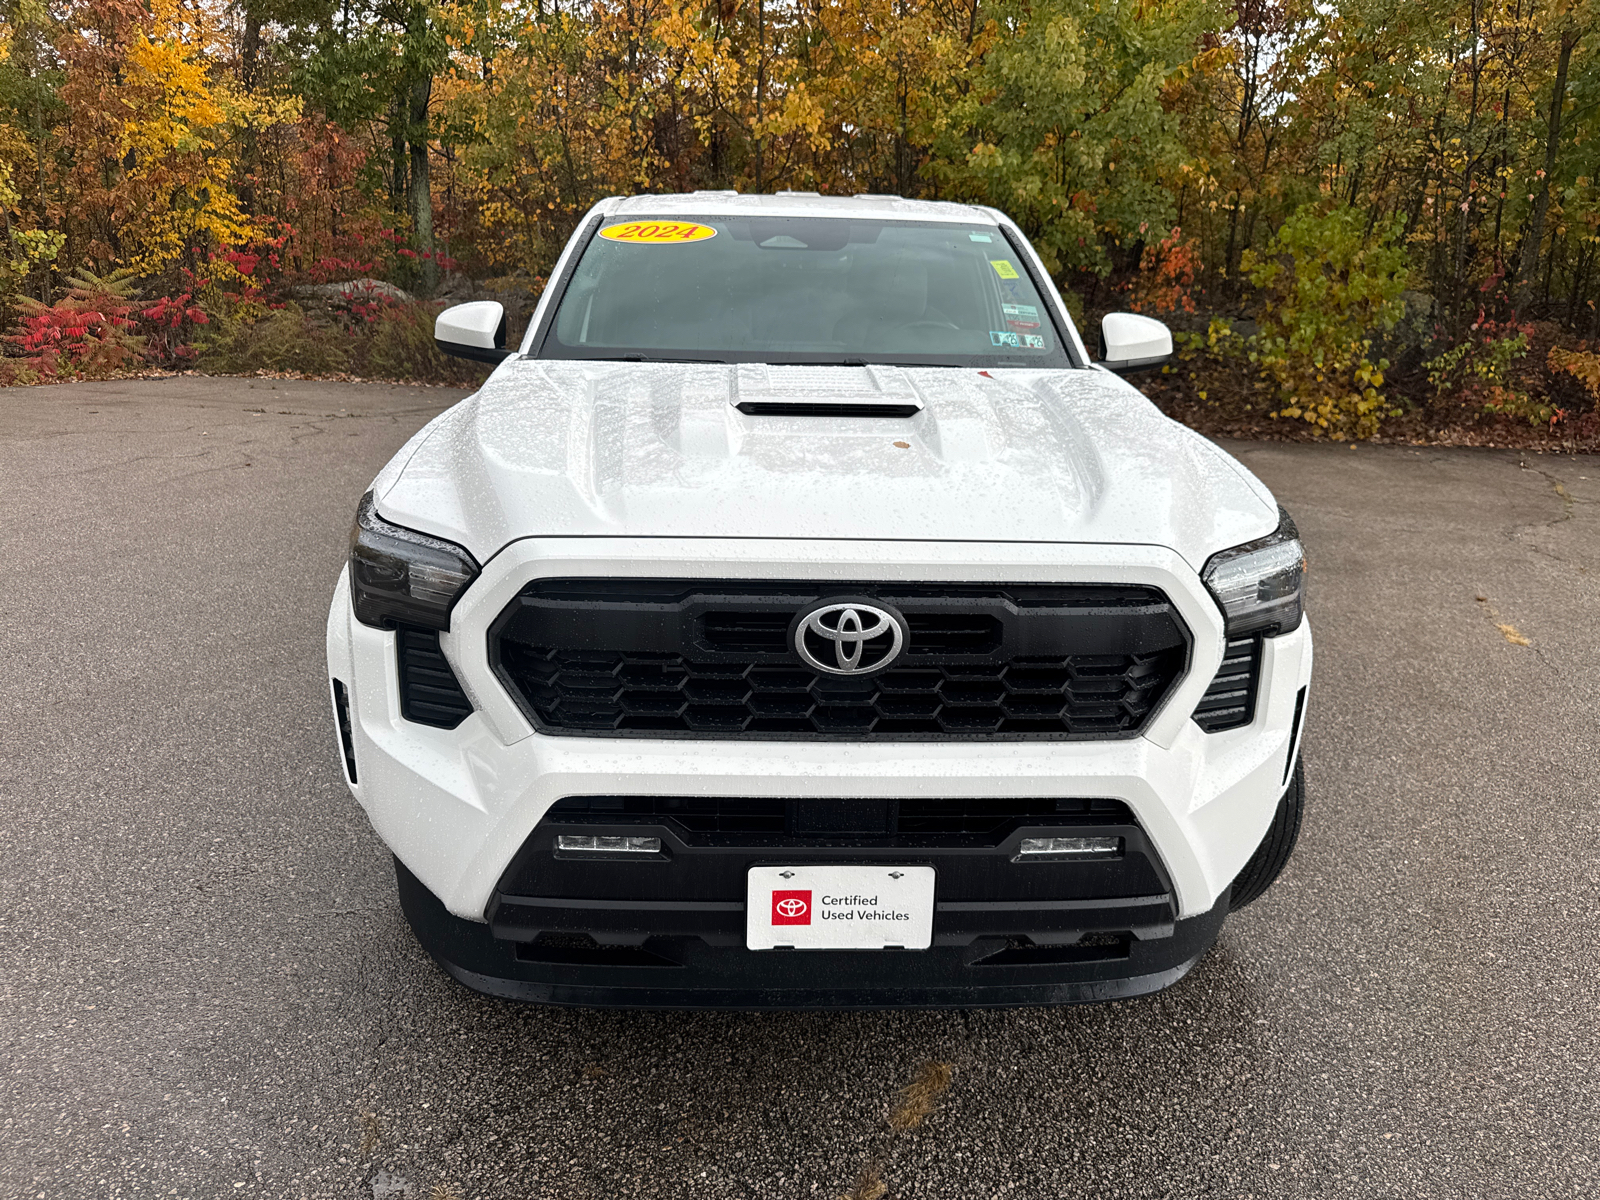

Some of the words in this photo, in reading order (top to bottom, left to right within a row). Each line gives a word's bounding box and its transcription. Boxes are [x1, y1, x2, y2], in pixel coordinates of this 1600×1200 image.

[616, 225, 700, 239] 2024
[821, 895, 878, 906] Certified
[821, 910, 854, 920] Used
[857, 910, 910, 921] Vehicles
